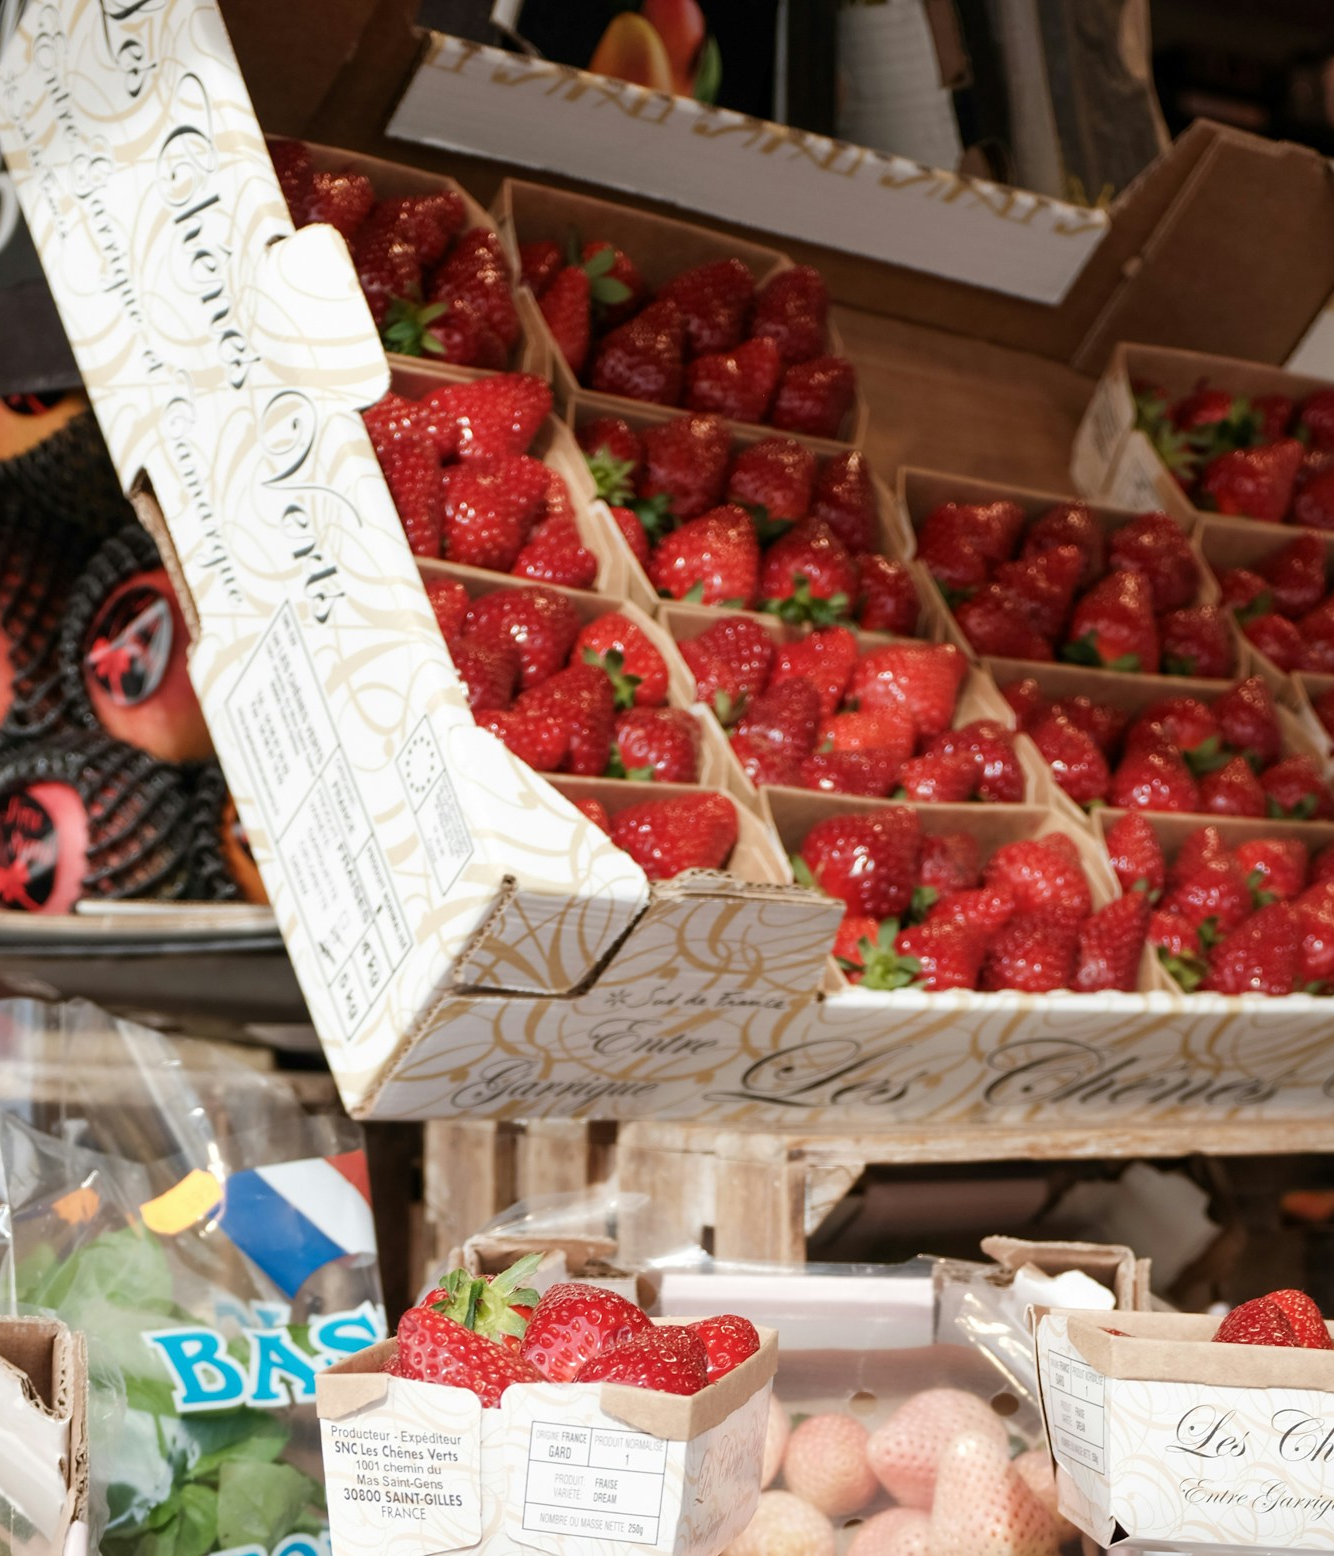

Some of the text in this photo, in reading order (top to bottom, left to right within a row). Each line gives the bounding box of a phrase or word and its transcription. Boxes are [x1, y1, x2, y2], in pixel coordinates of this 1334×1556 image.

[166, 369, 244, 604] Camargue
[260, 390, 362, 626] Verts
[589, 1019, 720, 1058] Entre
[703, 1038, 914, 1105] Les
[984, 1037, 1279, 1106] Chênes
[450, 1058, 659, 1106] Garrigue
[331, 1425, 462, 1445] Producteur Expéditeur
[561, 1430, 588, 1444] FRANCE
[593, 1434, 624, 1449] PRODUIT
[1165, 1404, 1249, 1460] Les
[334, 1440, 459, 1462] SNC Les Chênes Verts
[548, 1445, 571, 1459] GARD
[356, 1459, 442, 1475] 1001 chemin du
[356, 1474, 444, 1490] Mas Saint-Gens
[595, 1477, 618, 1490] FRAISE
[1178, 1476, 1248, 1506] Entre
[343, 1487, 463, 1507] 30800 SAINT-GILLES
[593, 1491, 617, 1504] DREAM
[381, 1506, 426, 1520] FRANCE
[539, 1512, 604, 1530] NOMBRE MASSE
